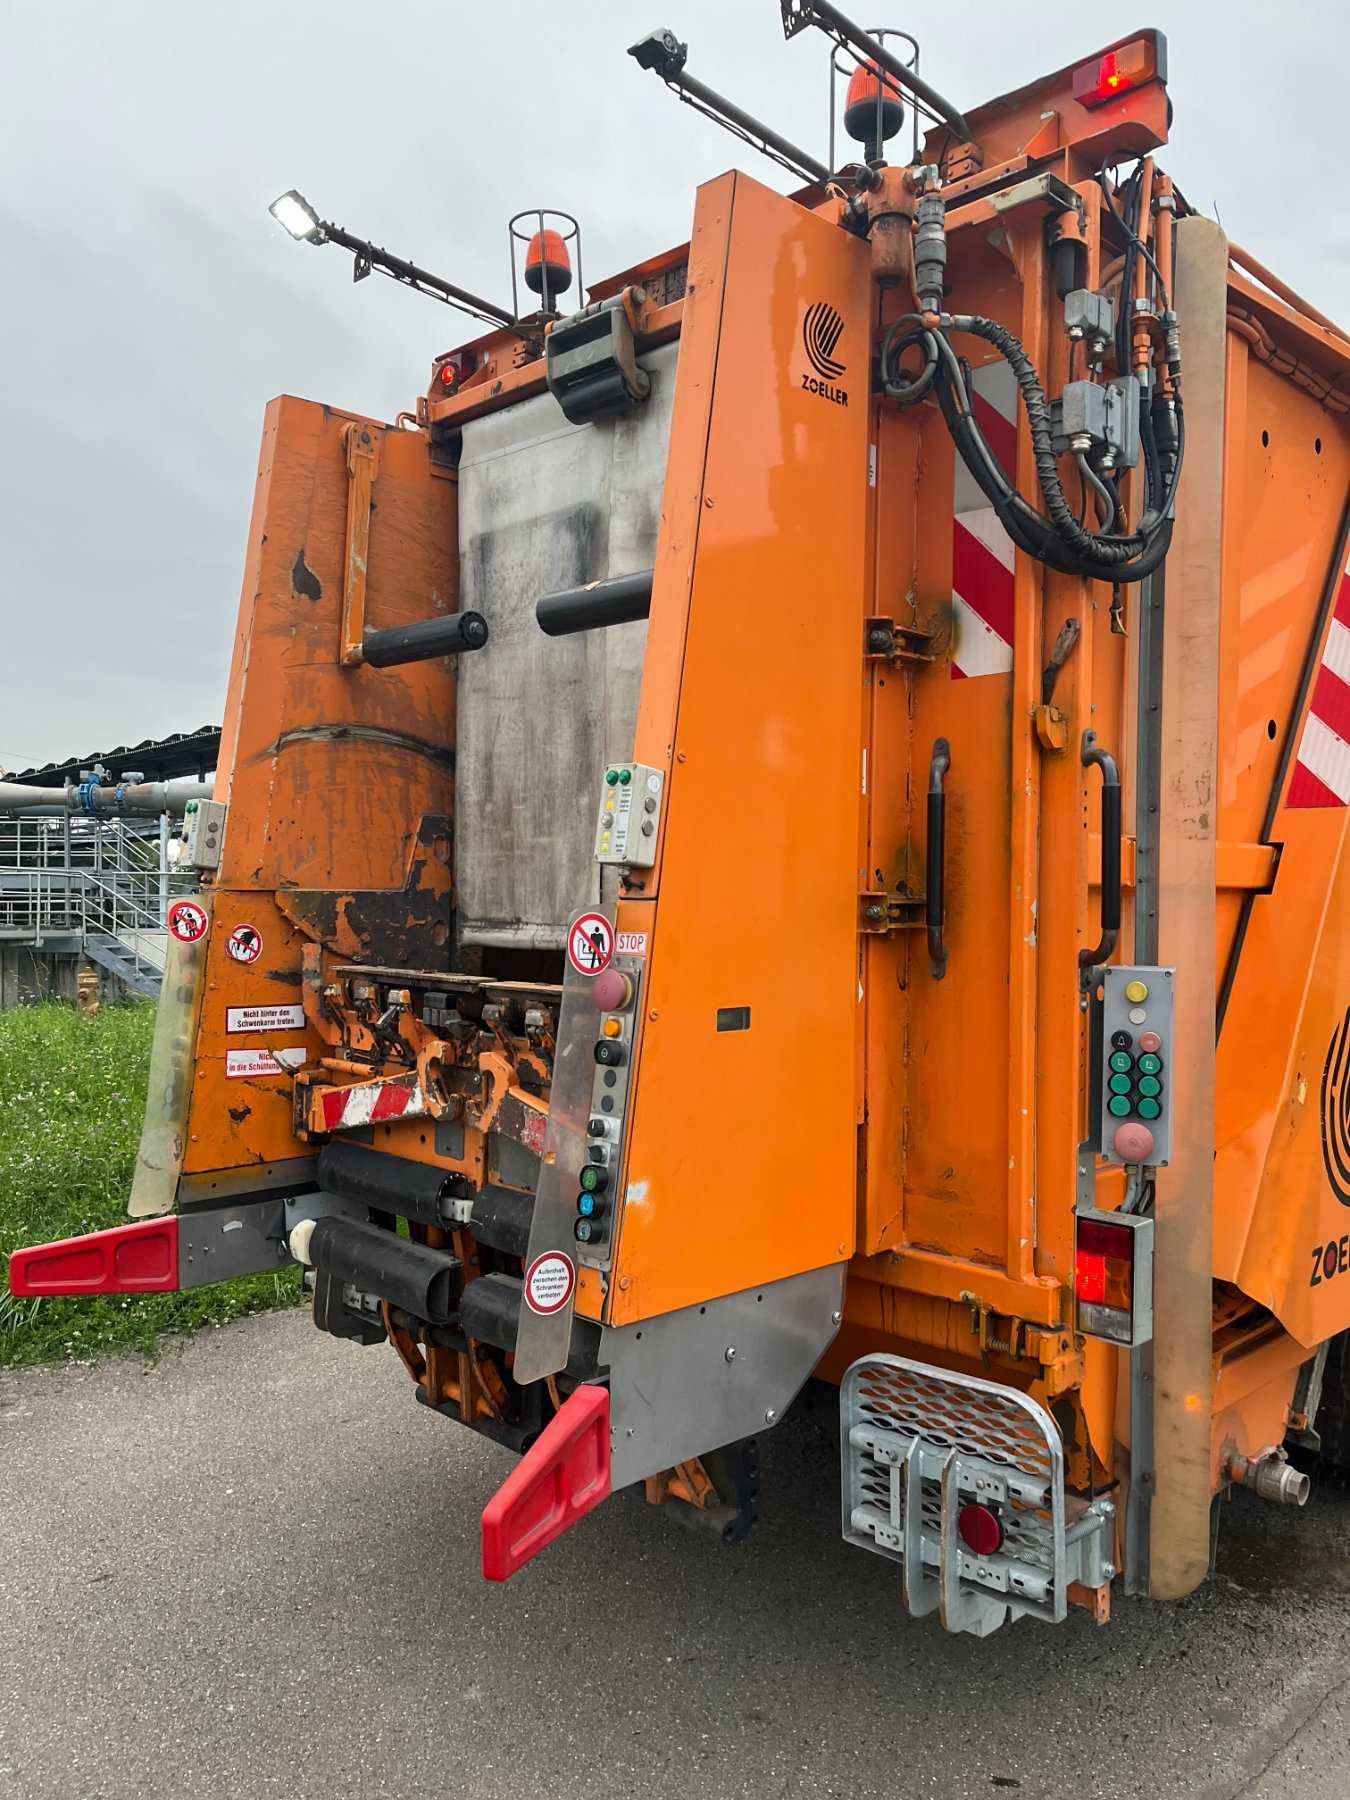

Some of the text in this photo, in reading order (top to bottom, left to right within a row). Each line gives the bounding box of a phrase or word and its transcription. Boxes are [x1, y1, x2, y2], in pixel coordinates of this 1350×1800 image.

[801, 374, 849, 407] ZOELLER
[619, 934, 644, 951] STOP
[242, 1008, 290, 1018] Nicht hinter den
[237, 1019, 275, 1028] Schwenkarm
[1309, 1233, 1350, 1288] ZOE
